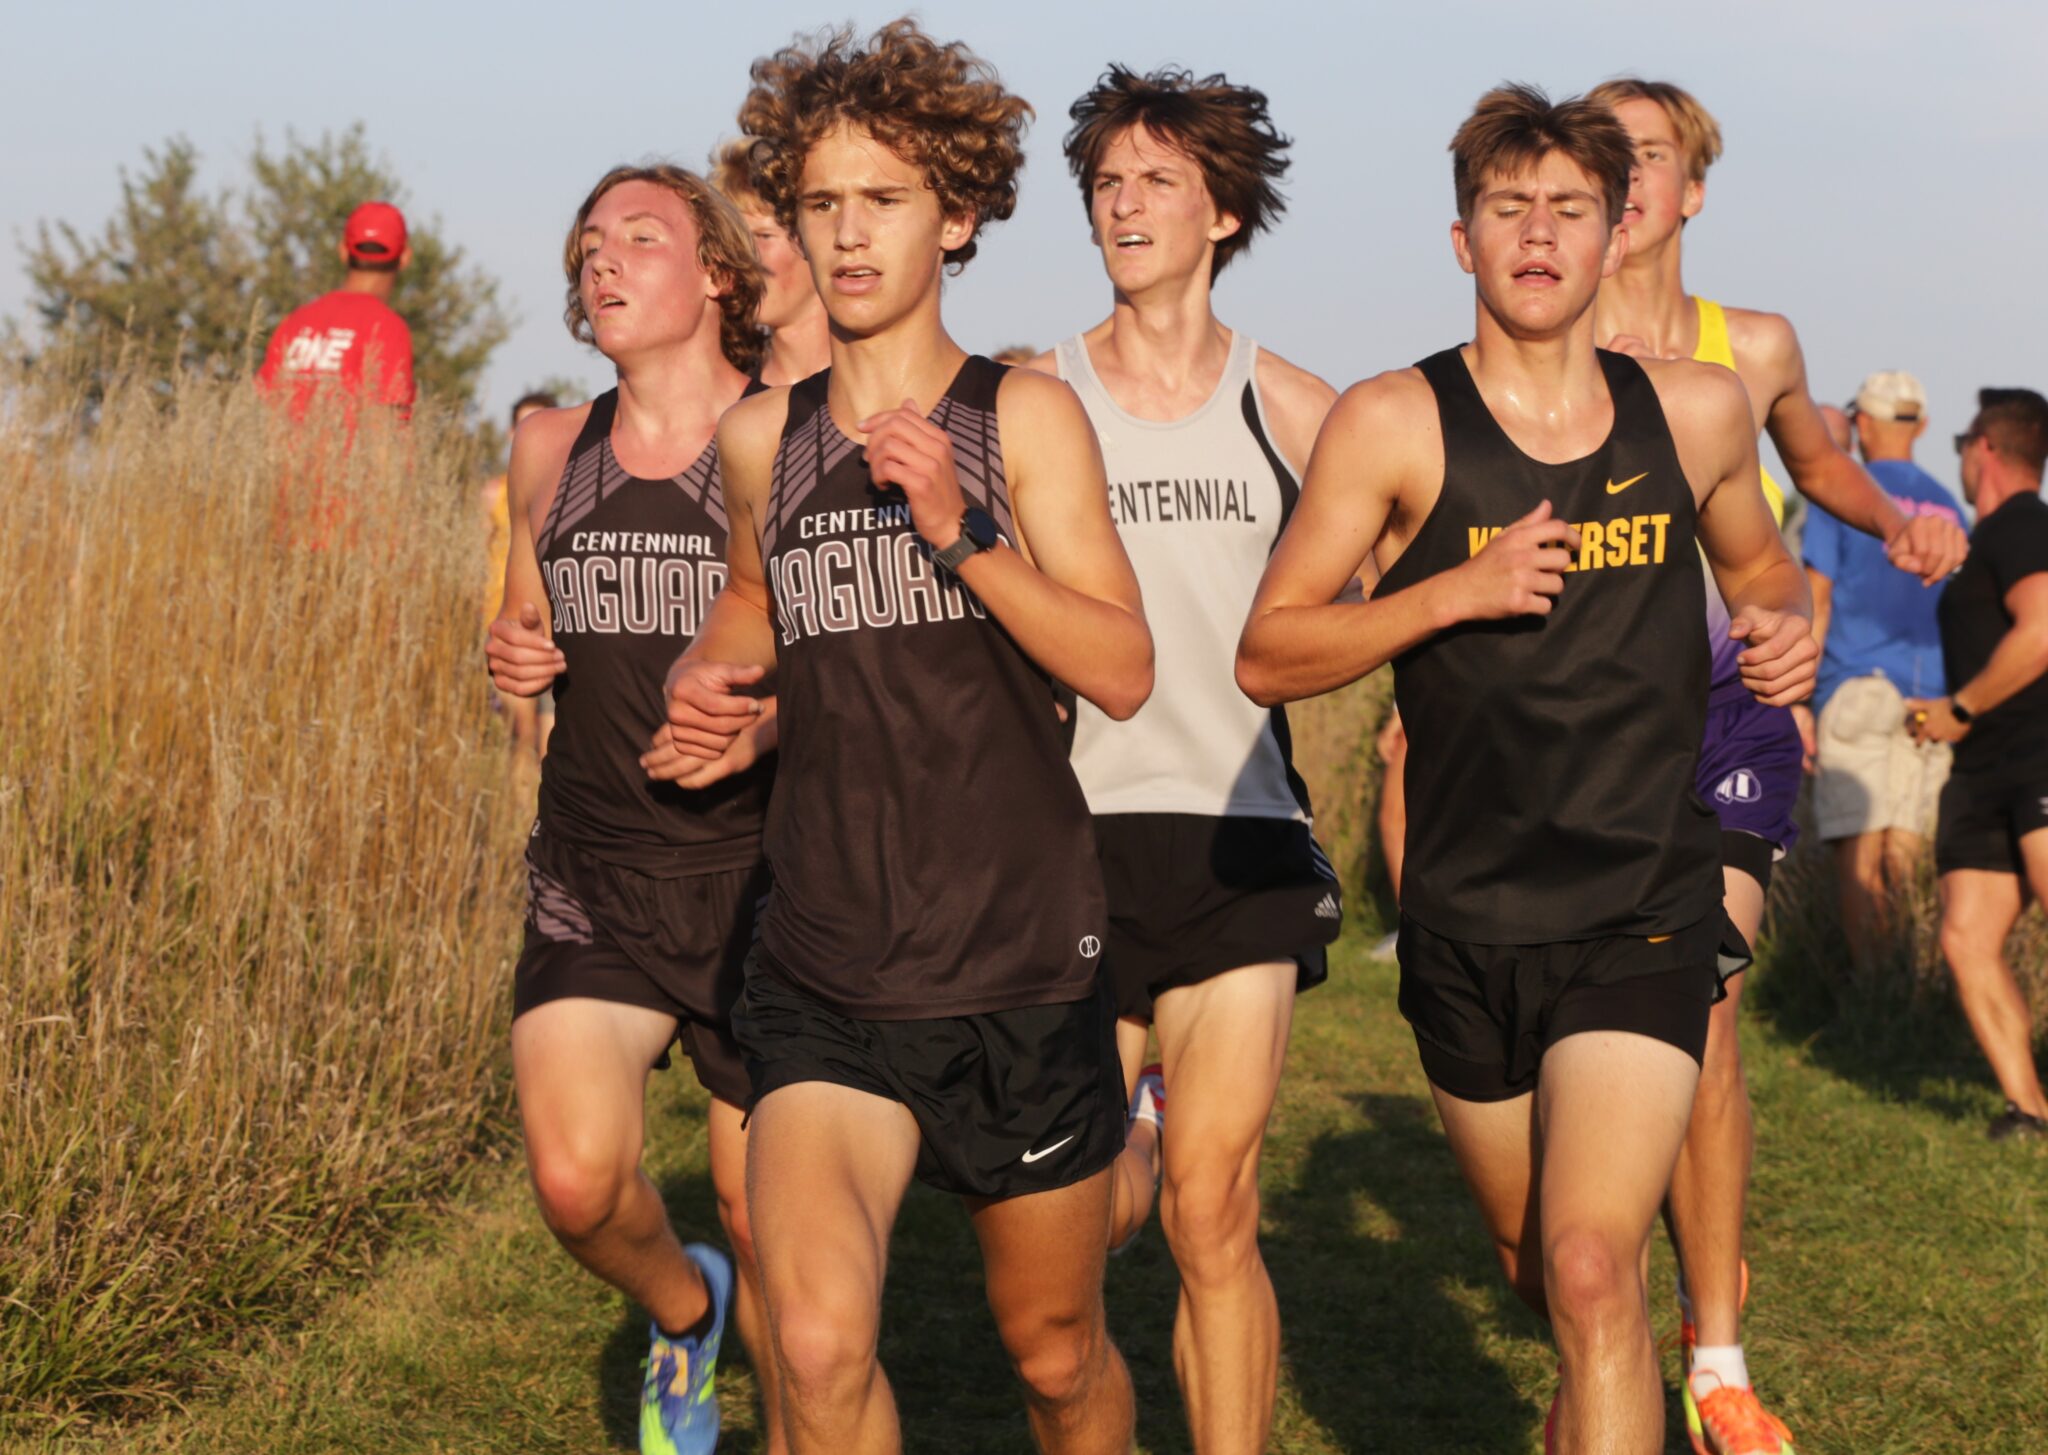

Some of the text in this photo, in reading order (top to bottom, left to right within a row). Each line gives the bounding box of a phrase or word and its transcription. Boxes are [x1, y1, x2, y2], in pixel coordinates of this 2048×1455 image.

[800, 504, 911, 539] CENTENN
[572, 531, 717, 557] CENTENNIAL
[770, 532, 1009, 646] JAGUAR
